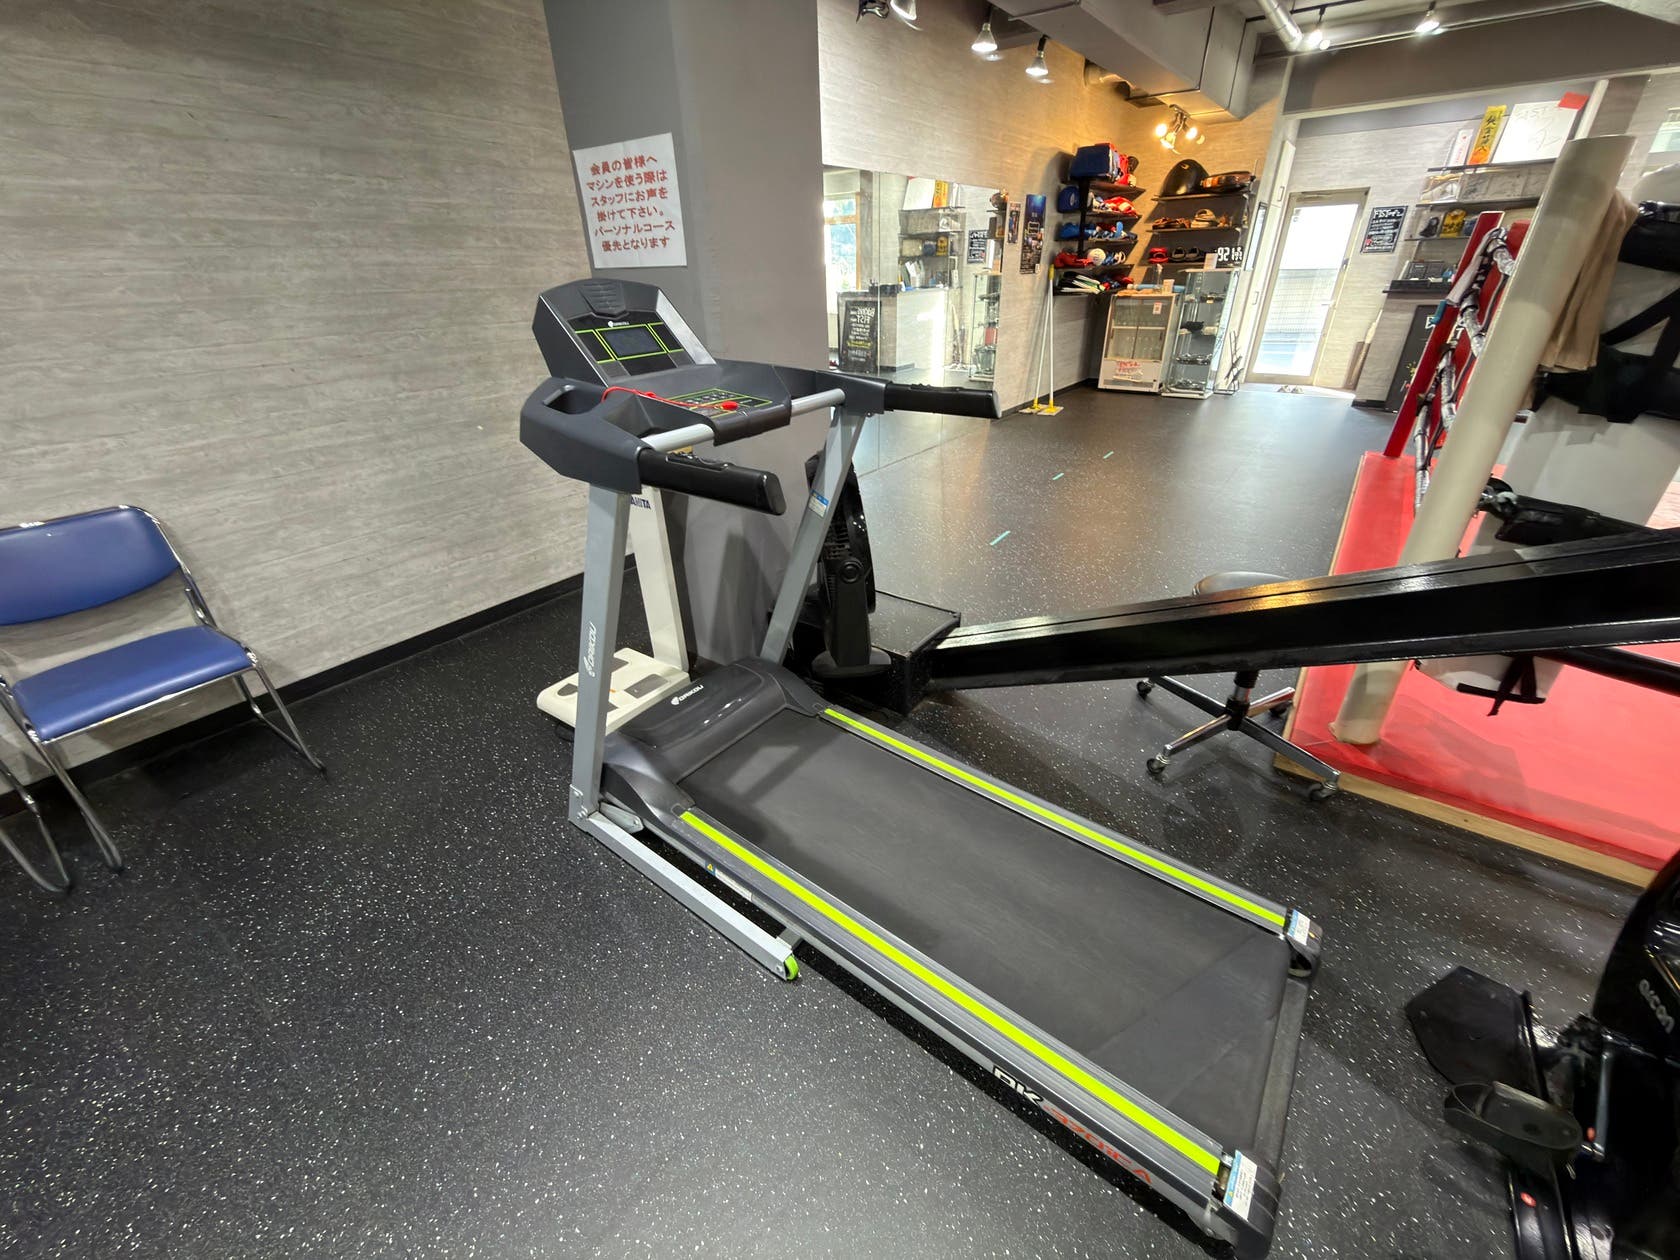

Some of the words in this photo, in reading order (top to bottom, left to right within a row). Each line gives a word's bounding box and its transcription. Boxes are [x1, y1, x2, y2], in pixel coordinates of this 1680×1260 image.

[589, 154, 658, 176] 会員の皆様へ
[586, 169, 668, 192] マシンを使う際は
[591, 187, 668, 207] スタッフにお声を
[597, 206, 664, 222] 掛けて下さい。
[595, 220, 675, 237] パーソナルコース
[602, 236, 670, 252] 優先となります
[630, 495, 652, 510] ANITA
